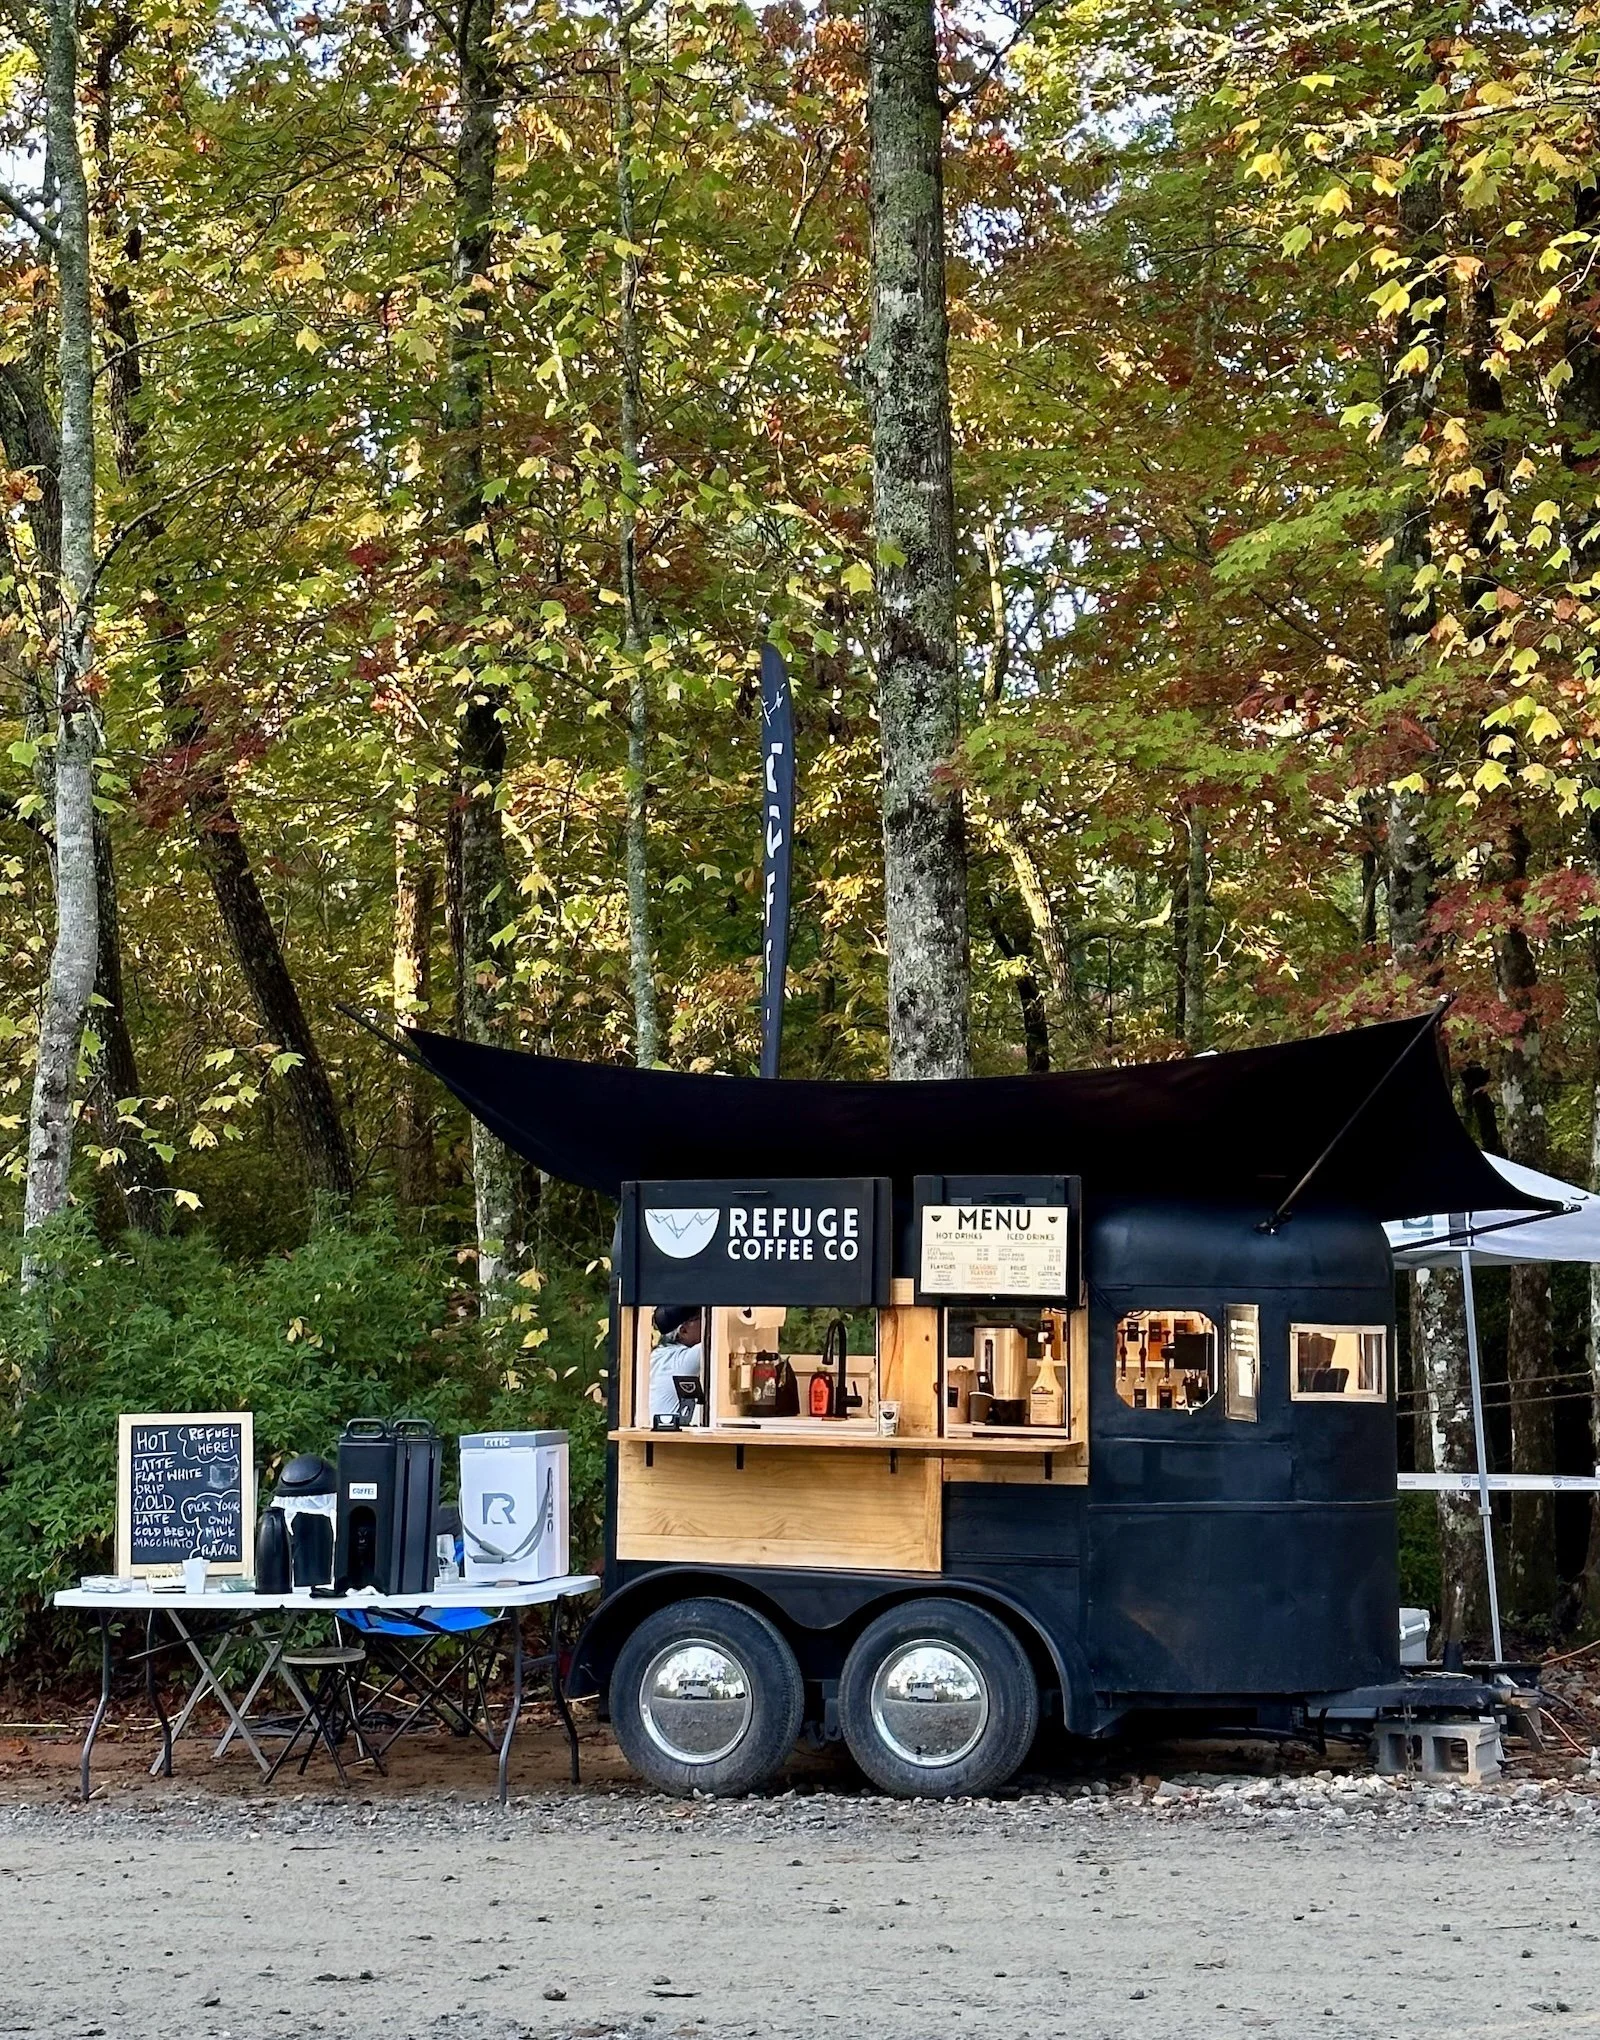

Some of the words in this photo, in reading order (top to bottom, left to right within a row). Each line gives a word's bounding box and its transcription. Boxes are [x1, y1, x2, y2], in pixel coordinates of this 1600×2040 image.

[728, 1207, 860, 1238] REFUGE
[958, 1208, 1031, 1231] MENU
[936, 1232, 952, 1240] HOT
[955, 1232, 983, 1240] DRINKS
[727, 1238, 814, 1261] COFFEE
[823, 1238, 859, 1262] CO
[136, 1430, 169, 1452] HOT
[188, 1427, 239, 1441] REFUEL
[484, 1437, 510, 1447] RTIC
[134, 1457, 175, 1472] LATTE
[135, 1471, 165, 1485] FLAT
[167, 1468, 204, 1482] WHITE
[134, 1484, 165, 1495] DRIP
[134, 1495, 175, 1511] COLD
[186, 1501, 212, 1514] PICK
[214, 1500, 241, 1513] YOUR
[482, 1493, 516, 1524] R
[134, 1514, 171, 1525] LATTE
[134, 1526, 161, 1537] COLD
[163, 1526, 196, 1537] BREW
[204, 1526, 236, 1538] MILK
[134, 1537, 193, 1549] MACCHIATO
[201, 1543, 238, 1557] FLAVOR
